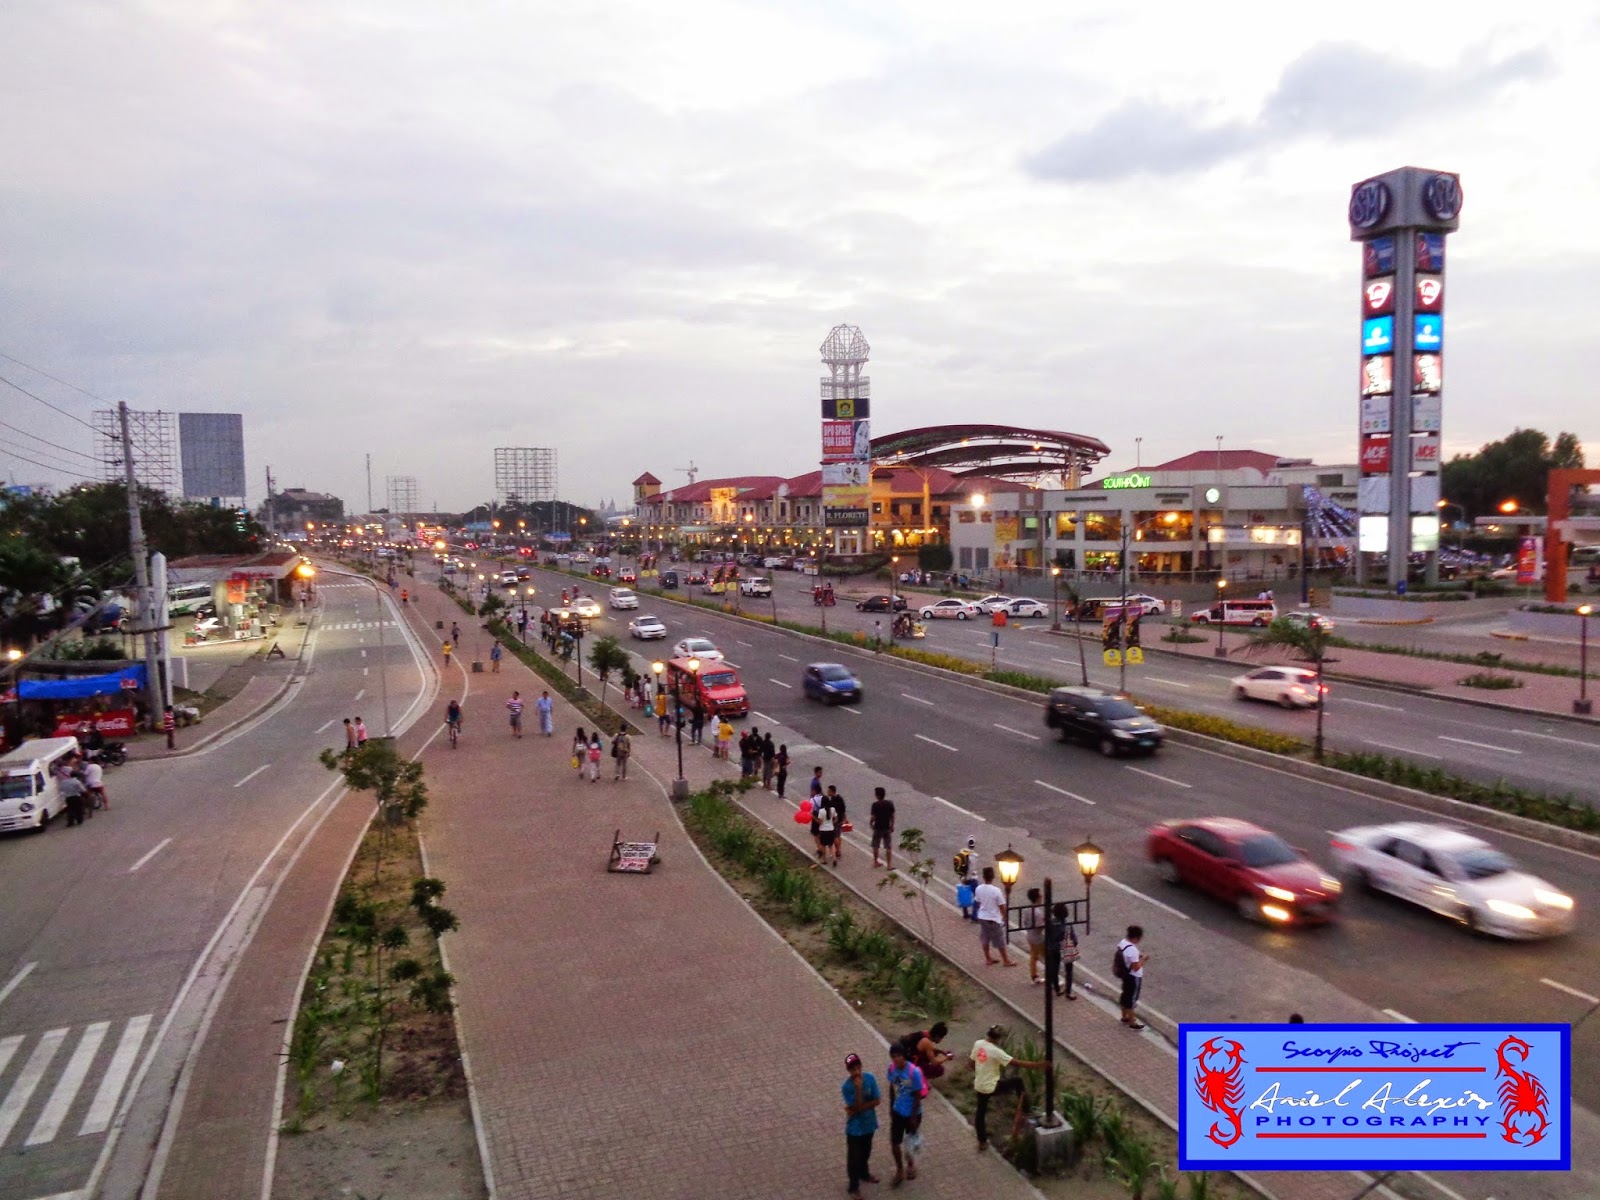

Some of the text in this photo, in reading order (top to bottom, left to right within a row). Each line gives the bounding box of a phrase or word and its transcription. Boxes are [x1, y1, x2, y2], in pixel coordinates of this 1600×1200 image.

[835, 425, 852, 436] SPACE
[823, 436, 852, 446] FOR LEASE
[1362, 446, 1388, 459] ACE
[1414, 446, 1438, 458] ACE
[1103, 474, 1151, 489] SOUTHPOINT
